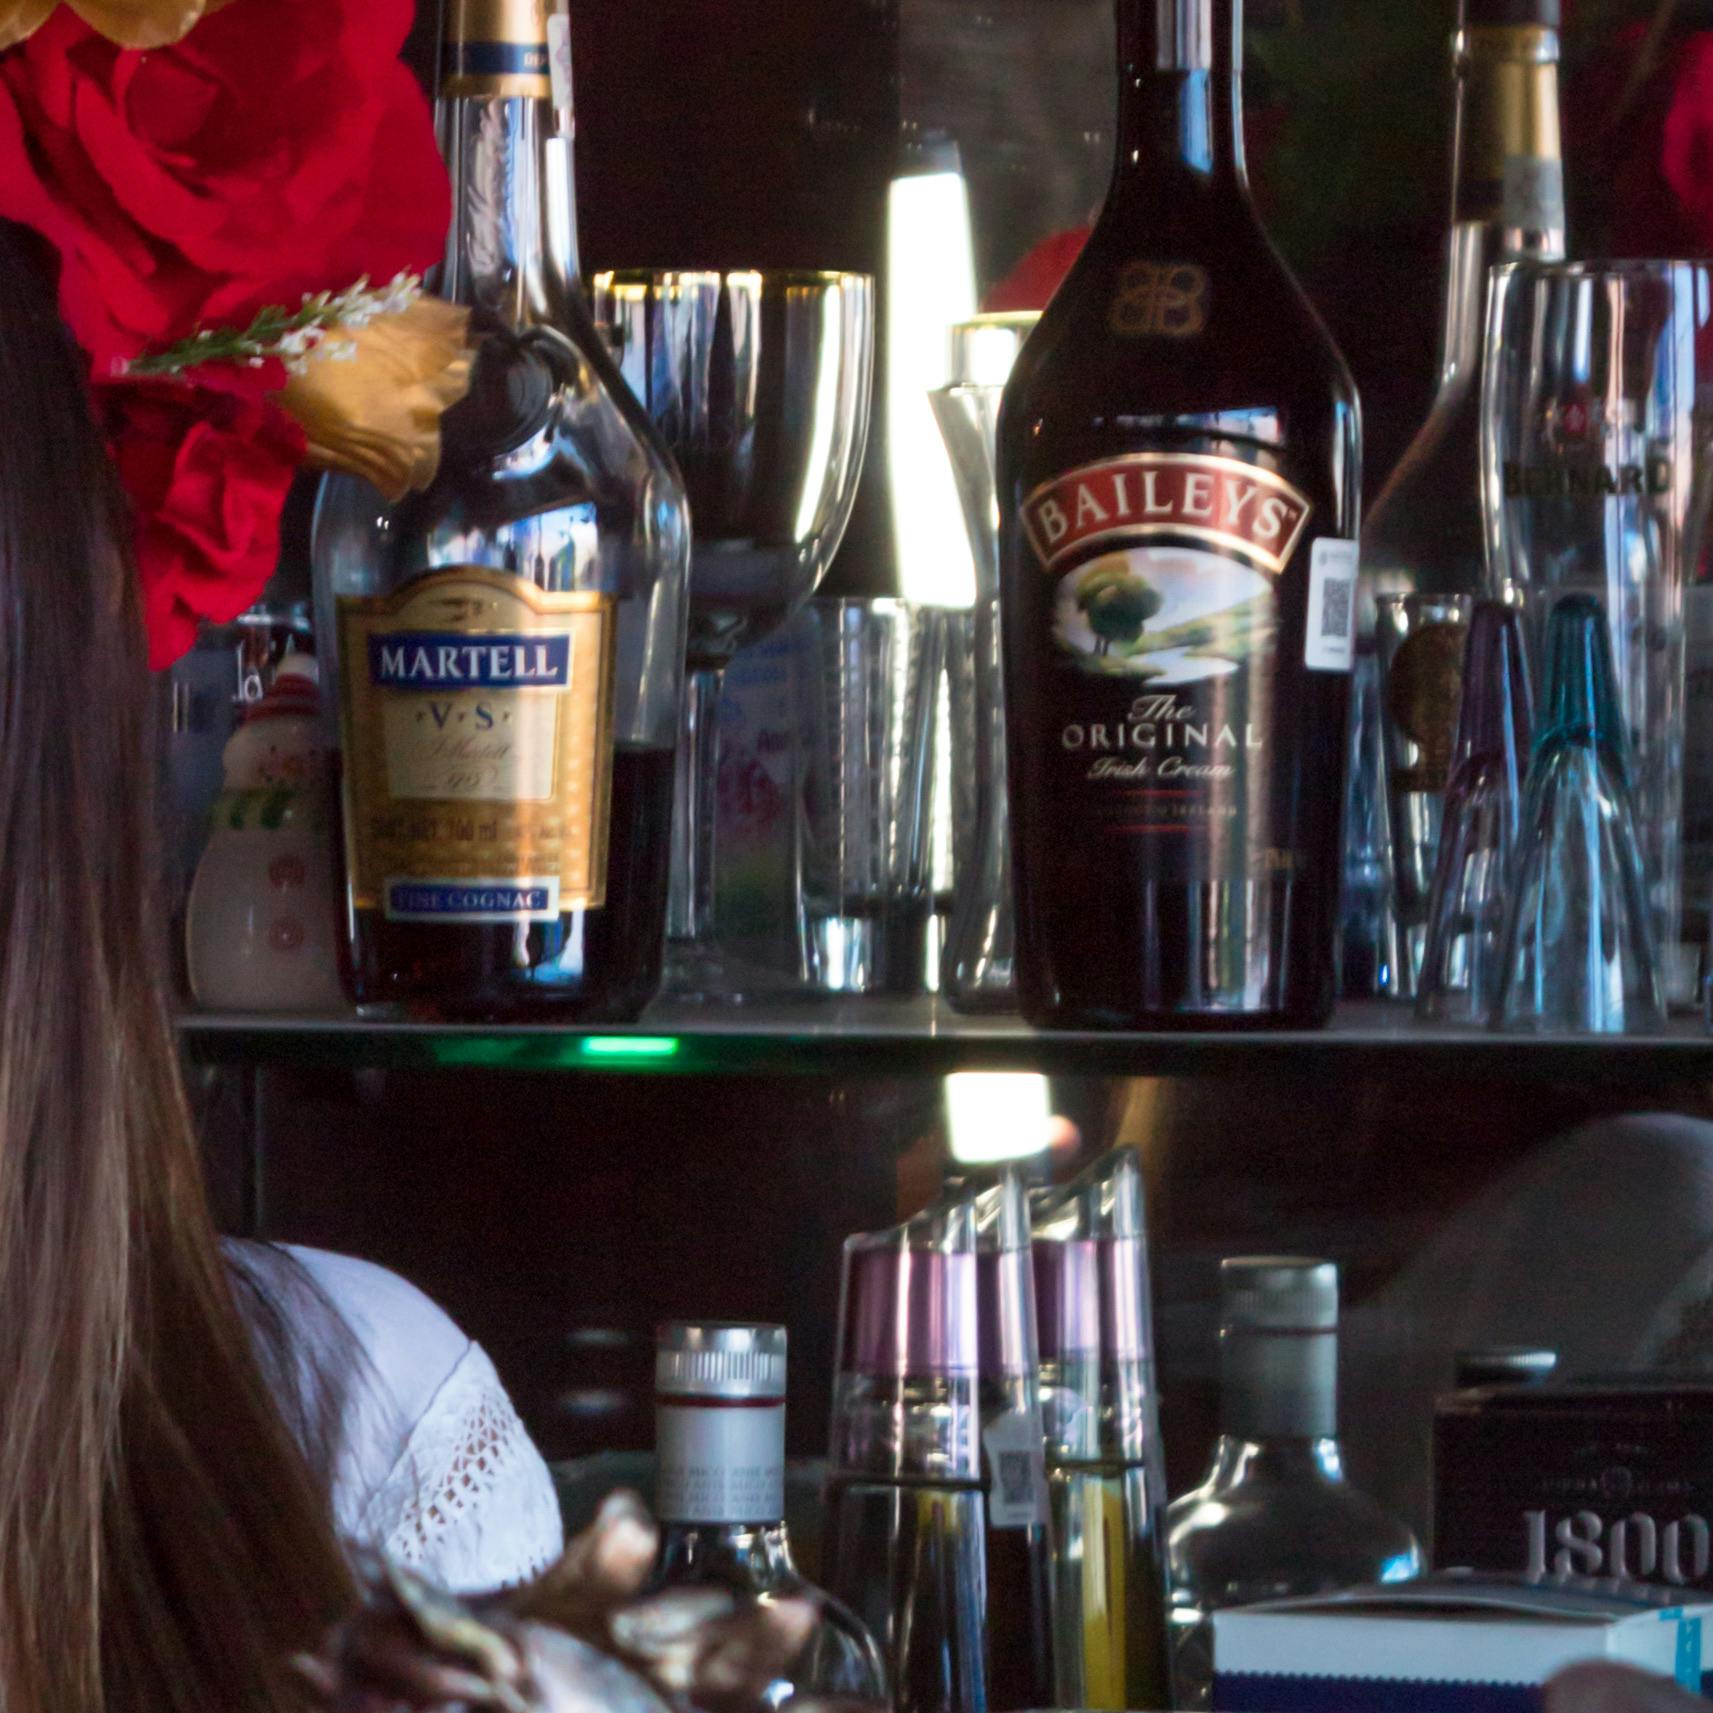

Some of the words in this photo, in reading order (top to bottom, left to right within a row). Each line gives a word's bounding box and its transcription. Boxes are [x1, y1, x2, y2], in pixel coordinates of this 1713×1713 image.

[1039, 470, 1287, 543] BAILEYS
[380, 643, 559, 680] MARTELL
[1127, 694, 1196, 722] The
[1061, 722, 1264, 750] ORIGINAL
[1089, 756, 1150, 780] Irish
[1156, 756, 1236, 779] Cream
[448, 889, 542, 908] COGNAC
[1523, 1509, 1710, 1584] 1800
